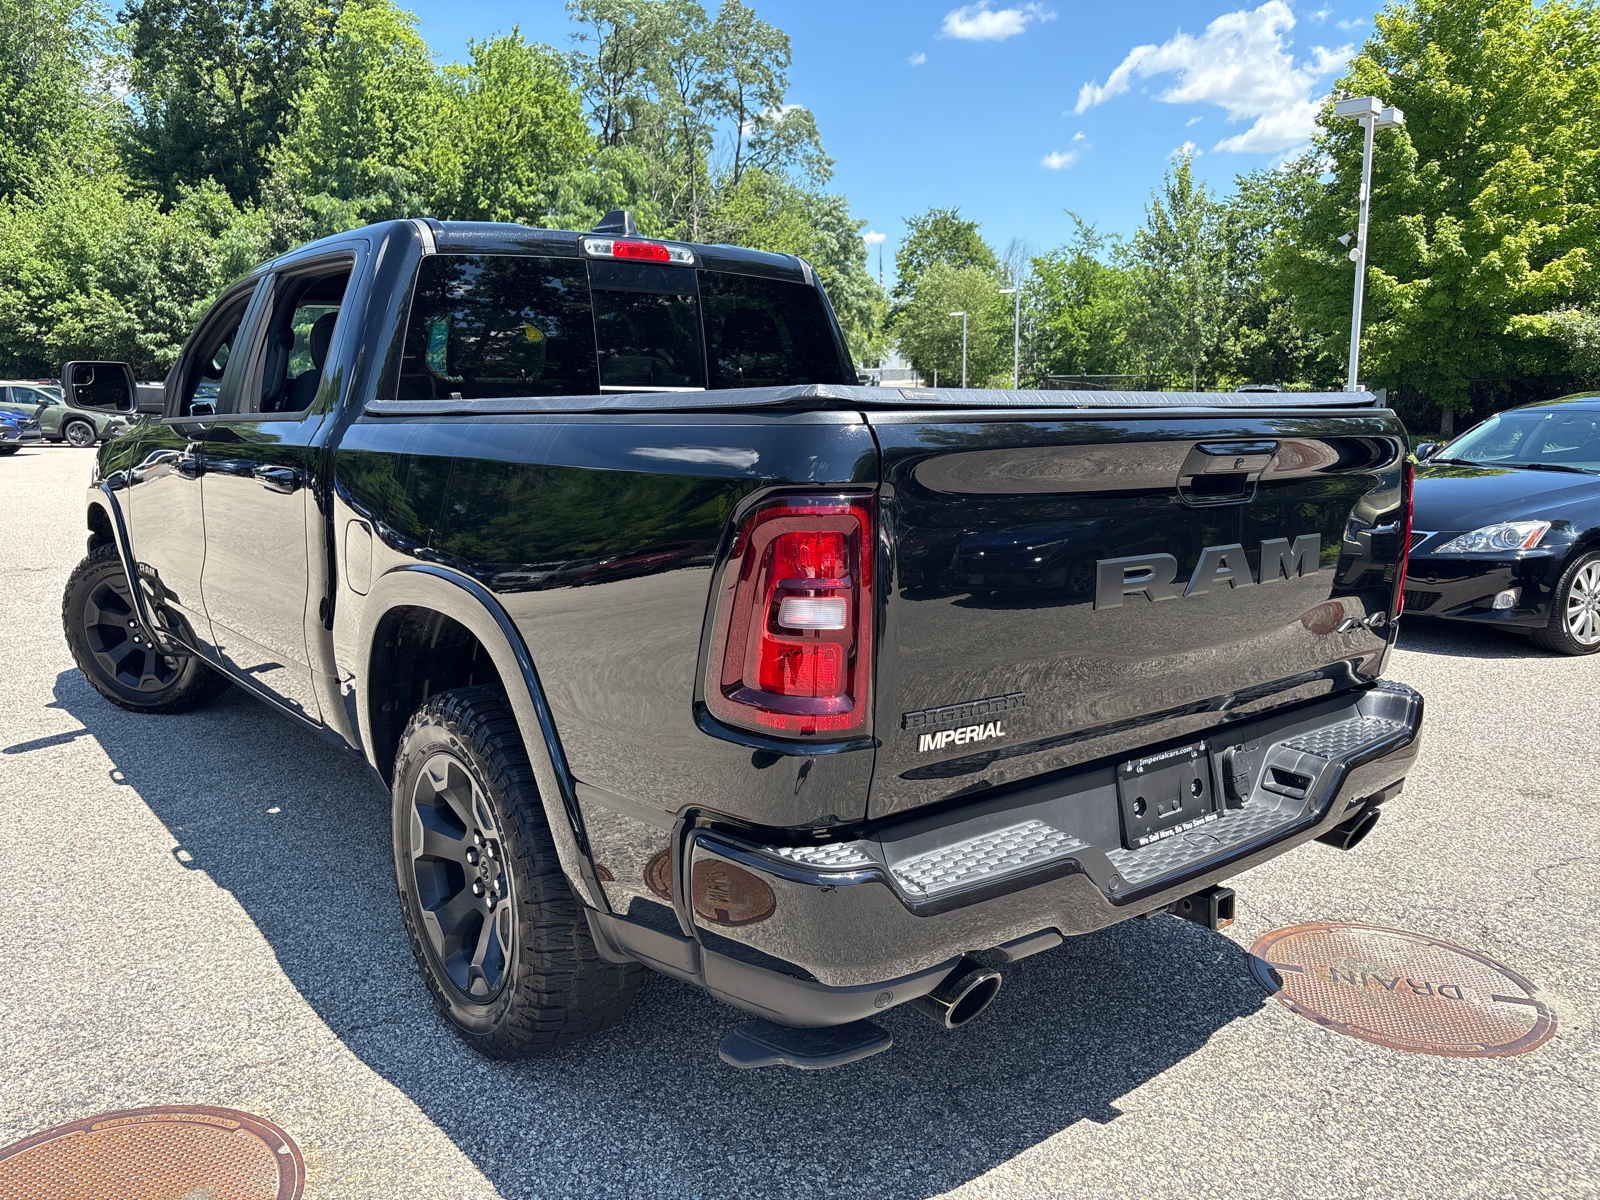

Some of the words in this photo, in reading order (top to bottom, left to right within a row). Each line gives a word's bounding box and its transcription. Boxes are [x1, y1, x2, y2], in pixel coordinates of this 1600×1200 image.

[139, 564, 156, 577] RAM
[1093, 533, 1321, 610] RAM
[917, 720, 1006, 752] IMPERIAL
[1139, 746, 1193, 766] Imperialcars.com
[1139, 837, 1150, 846] We
[1149, 833, 1160, 843] Sell
[1175, 826, 1183, 834] So
[1182, 822, 1193, 831] You
[1192, 818, 1205, 827] Save
[1205, 814, 1218, 823] More
[1330, 966, 1465, 1001] DRAIN
